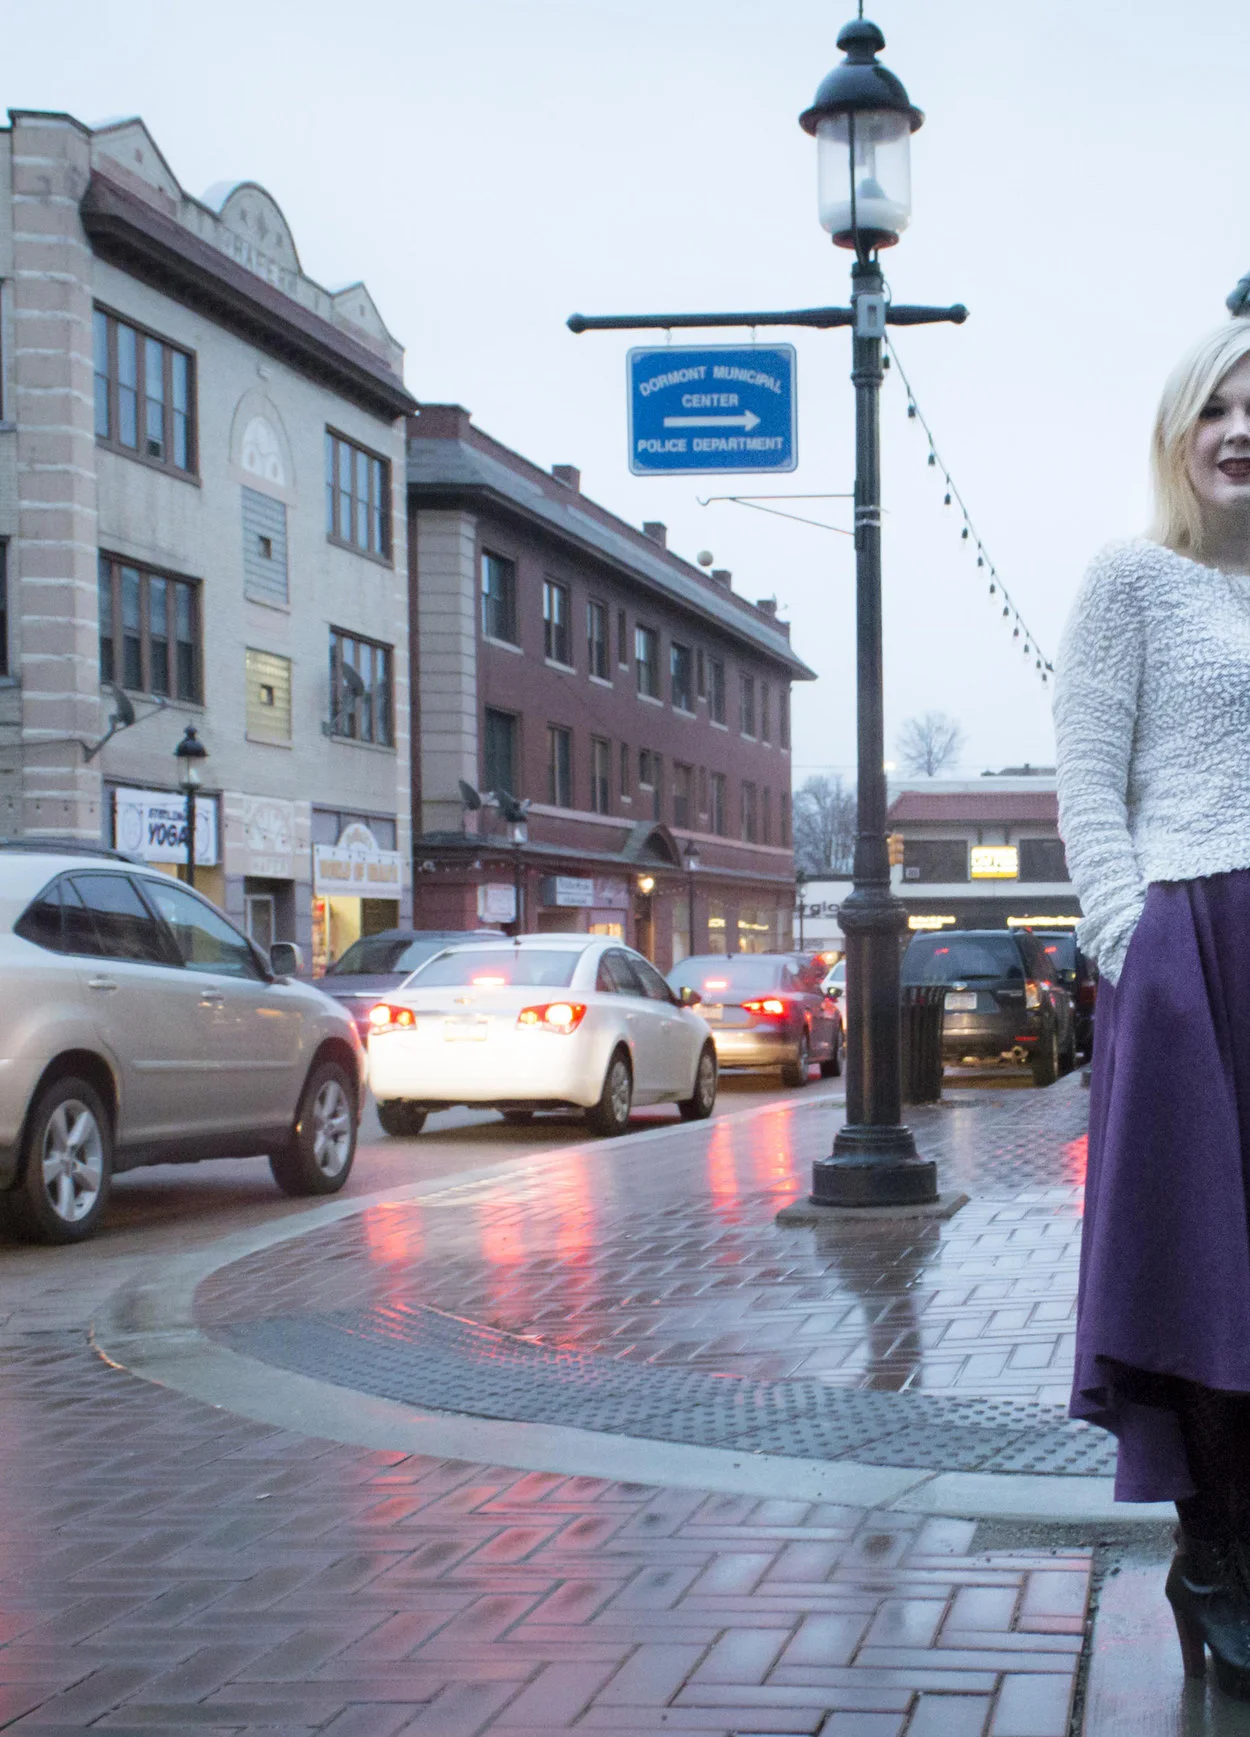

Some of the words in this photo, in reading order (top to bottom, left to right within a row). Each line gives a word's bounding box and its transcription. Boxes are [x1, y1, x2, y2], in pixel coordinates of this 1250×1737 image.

[639, 365, 706, 397] DORMONT
[713, 365, 783, 394] MUNICIPAL
[681, 393, 739, 408] CENTER
[637, 439, 687, 453] POLICE
[693, 437, 784, 452] DEPARTMENT
